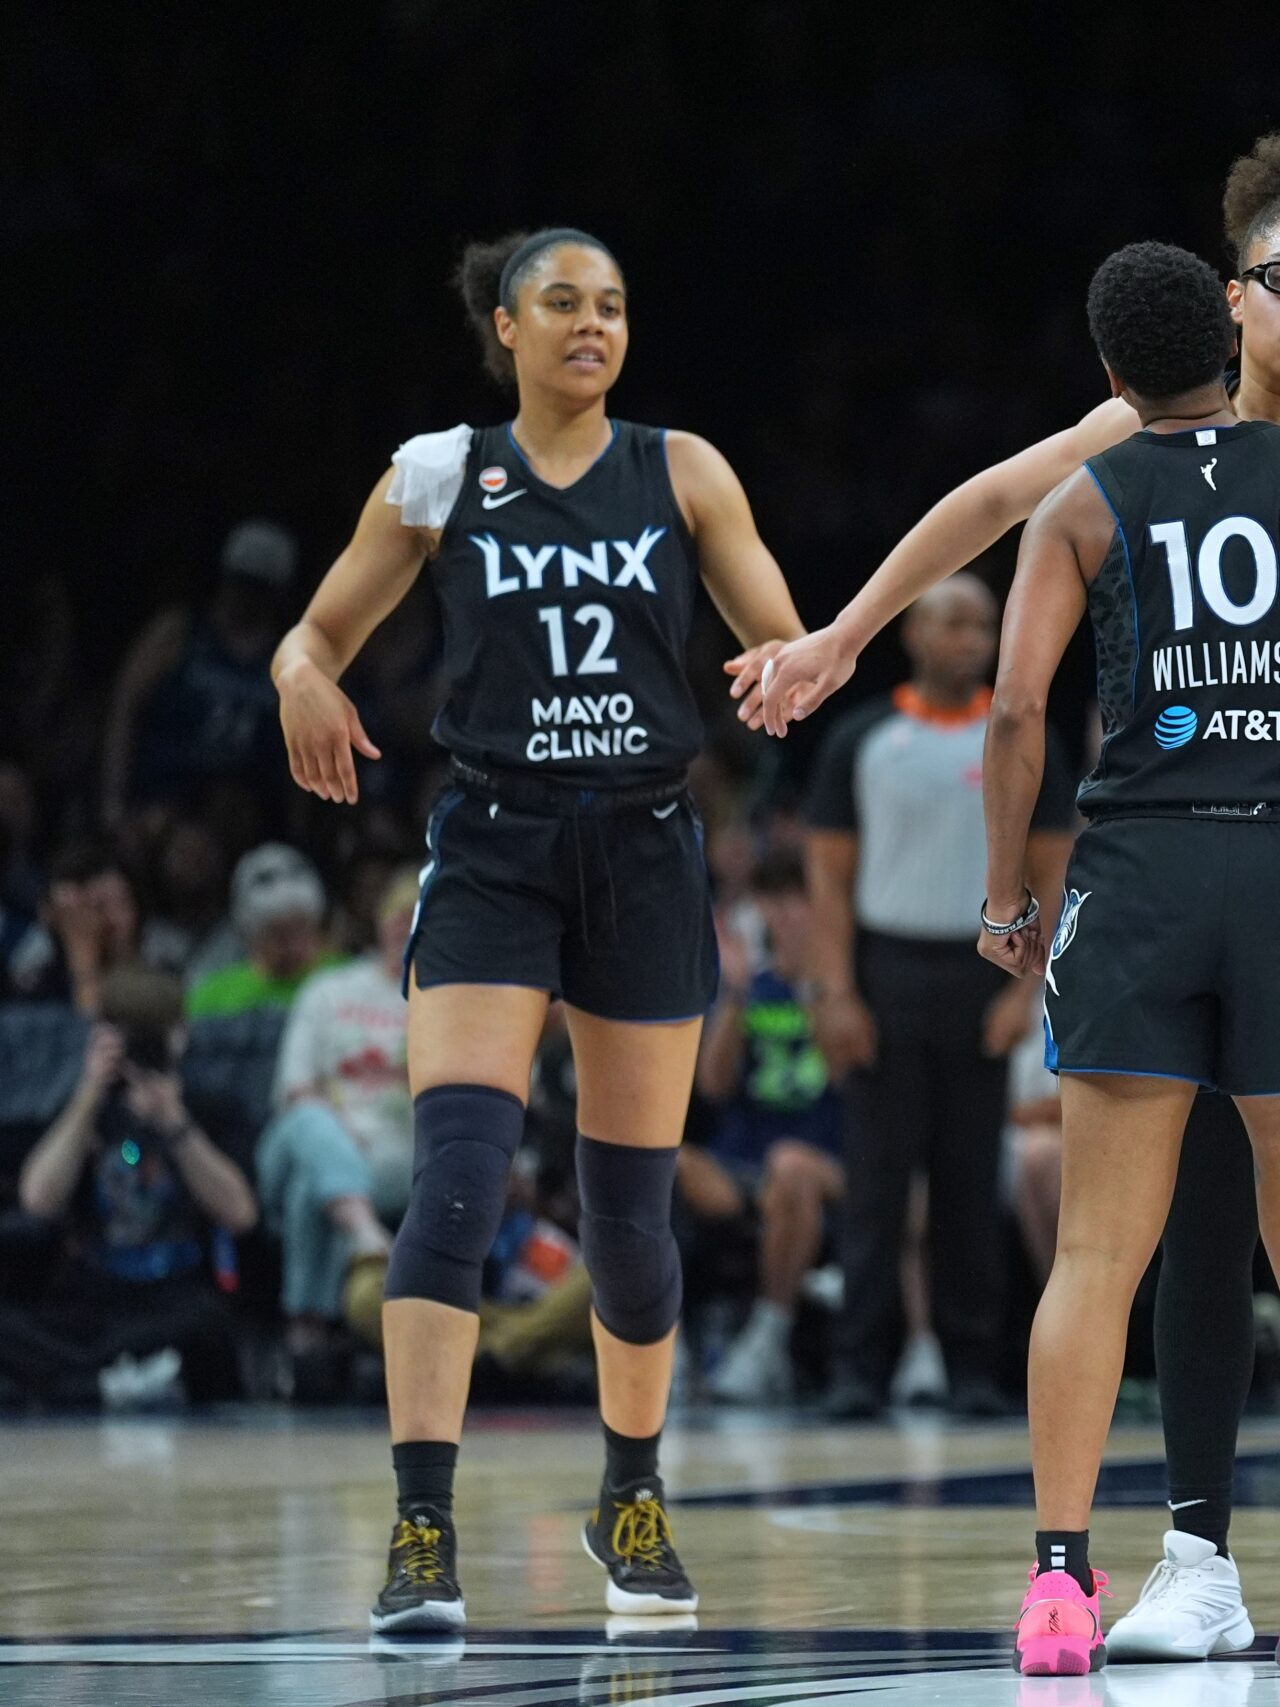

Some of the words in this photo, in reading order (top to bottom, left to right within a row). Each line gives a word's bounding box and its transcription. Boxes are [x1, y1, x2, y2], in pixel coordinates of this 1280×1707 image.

[469, 525, 667, 598] LYNX
[1149, 516, 1278, 631] 10
[538, 603, 618, 677] 12
[526, 726, 649, 761] CLINIC
[531, 693, 634, 727] MAYO
